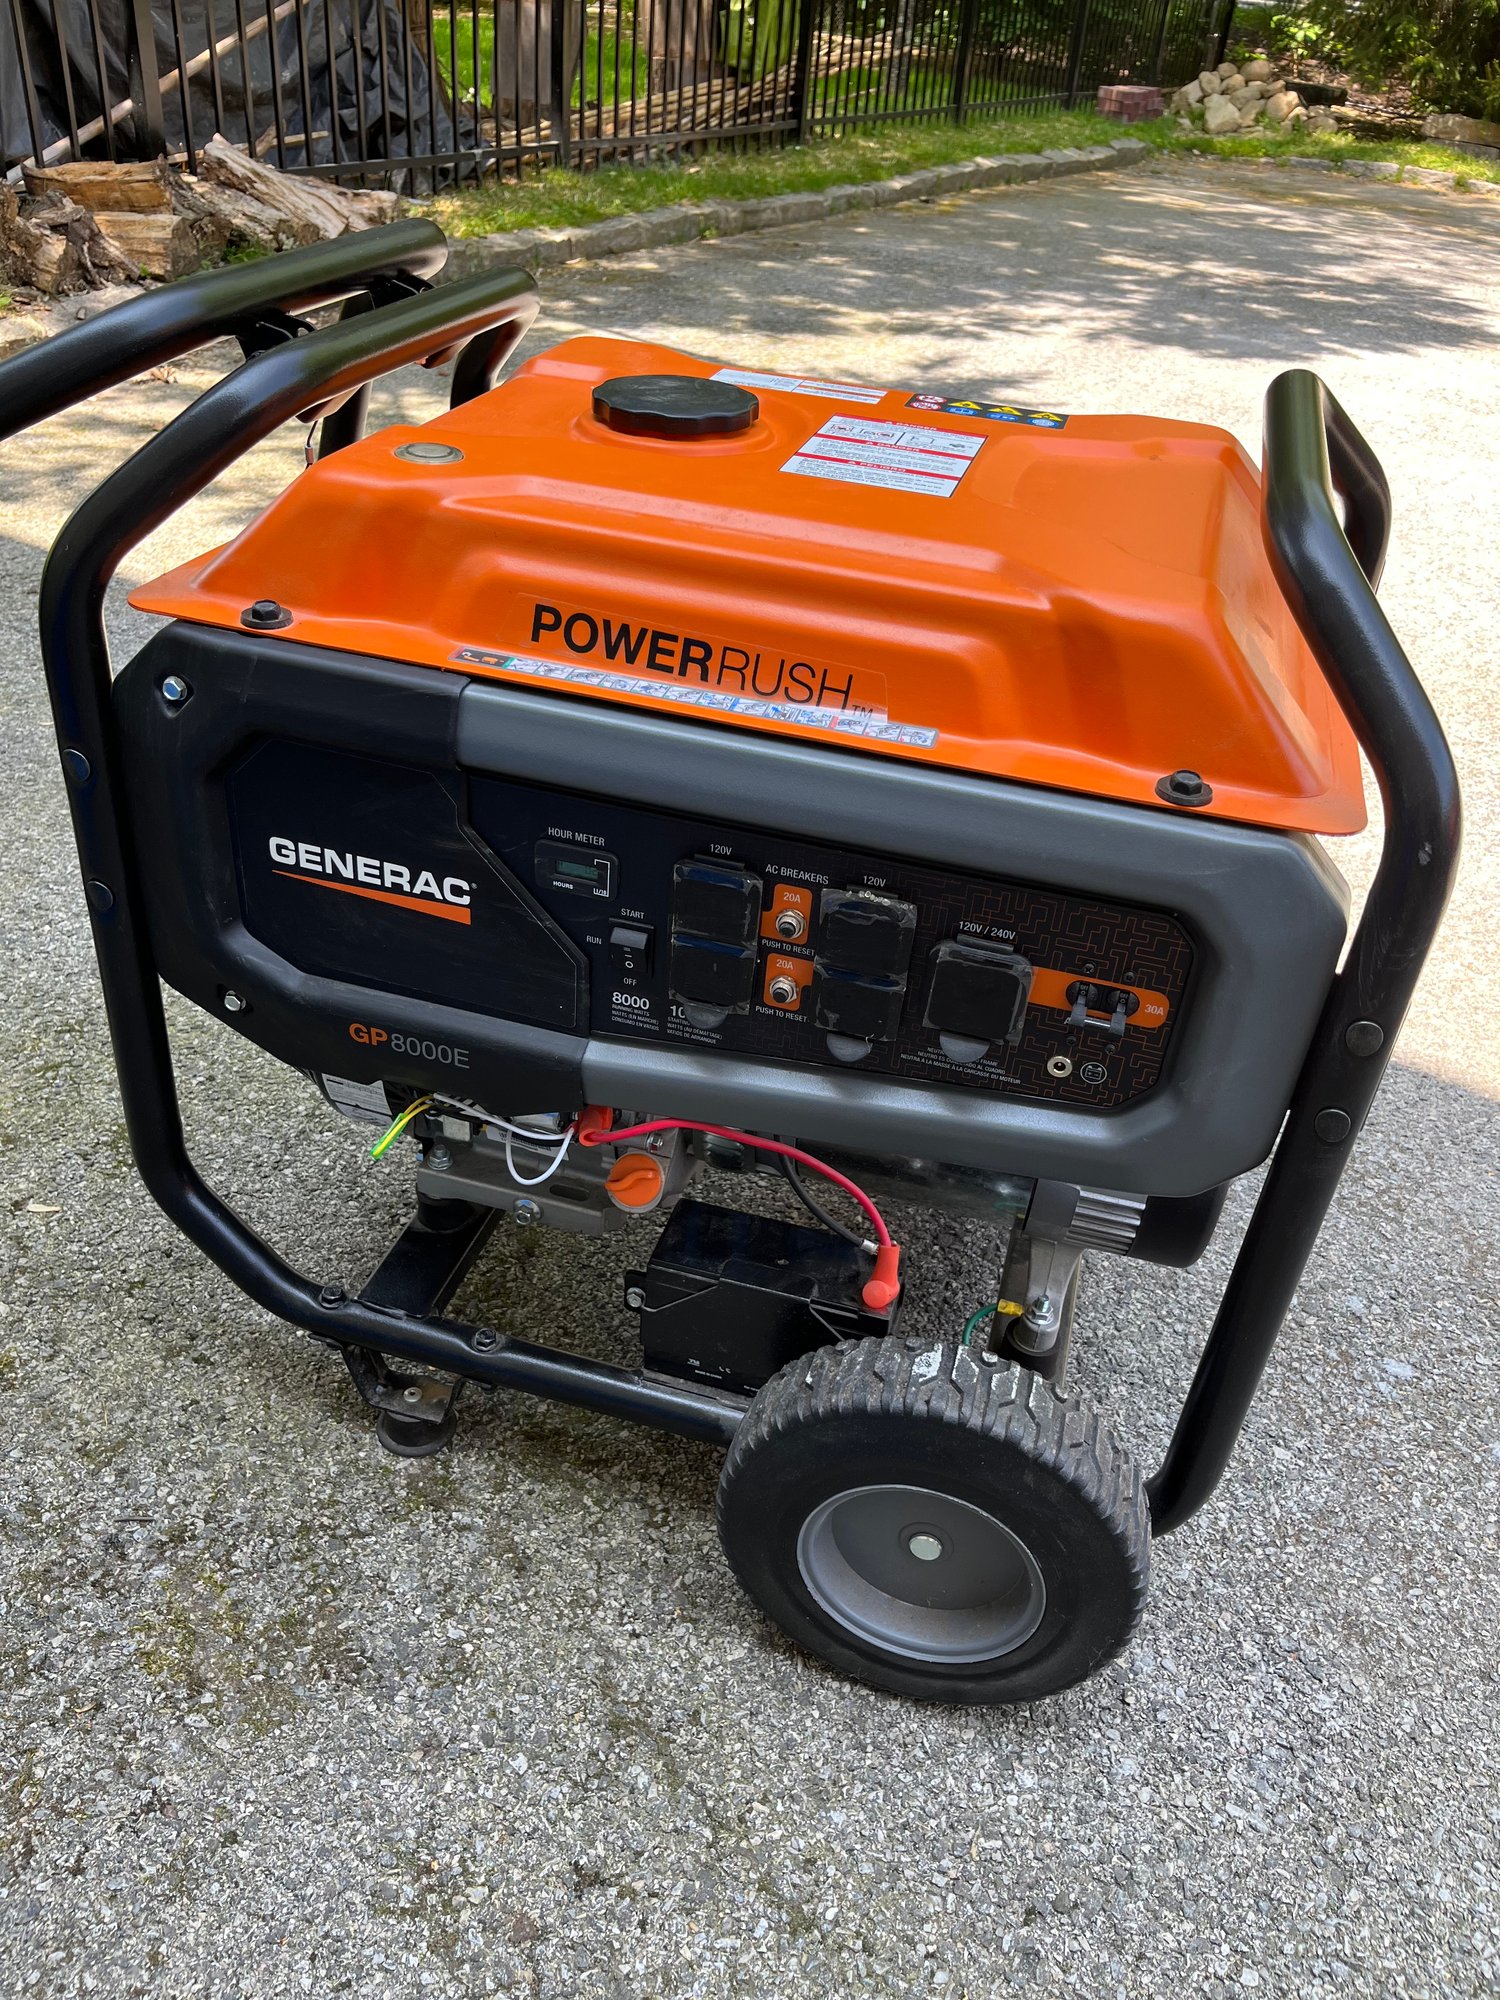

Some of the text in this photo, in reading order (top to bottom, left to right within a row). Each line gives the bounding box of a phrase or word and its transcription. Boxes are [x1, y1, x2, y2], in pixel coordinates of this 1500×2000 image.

[548, 827, 605, 846] HOUR METER
[710, 844, 732, 855] 120V
[269, 836, 471, 905] GENERAC
[765, 864, 829, 885] AC BREAKERS
[553, 881, 573, 890] HOURS
[863, 875, 886, 888] 120V
[783, 892, 801, 903] 20A
[621, 908, 645, 919] START
[958, 921, 983, 934] 120V
[991, 928, 1016, 941] 240V
[586, 935, 602, 945] RUN
[761, 939, 815, 956] PUSH TO RESET
[776, 959, 794, 970] 20A
[623, 977, 637, 986] OFF
[612, 992, 650, 1010] 8000
[755, 1006, 808, 1023] PUSH TO RESET
[1145, 1004, 1164, 1016] 30A
[349, 1023, 471, 1069] GP8000E
